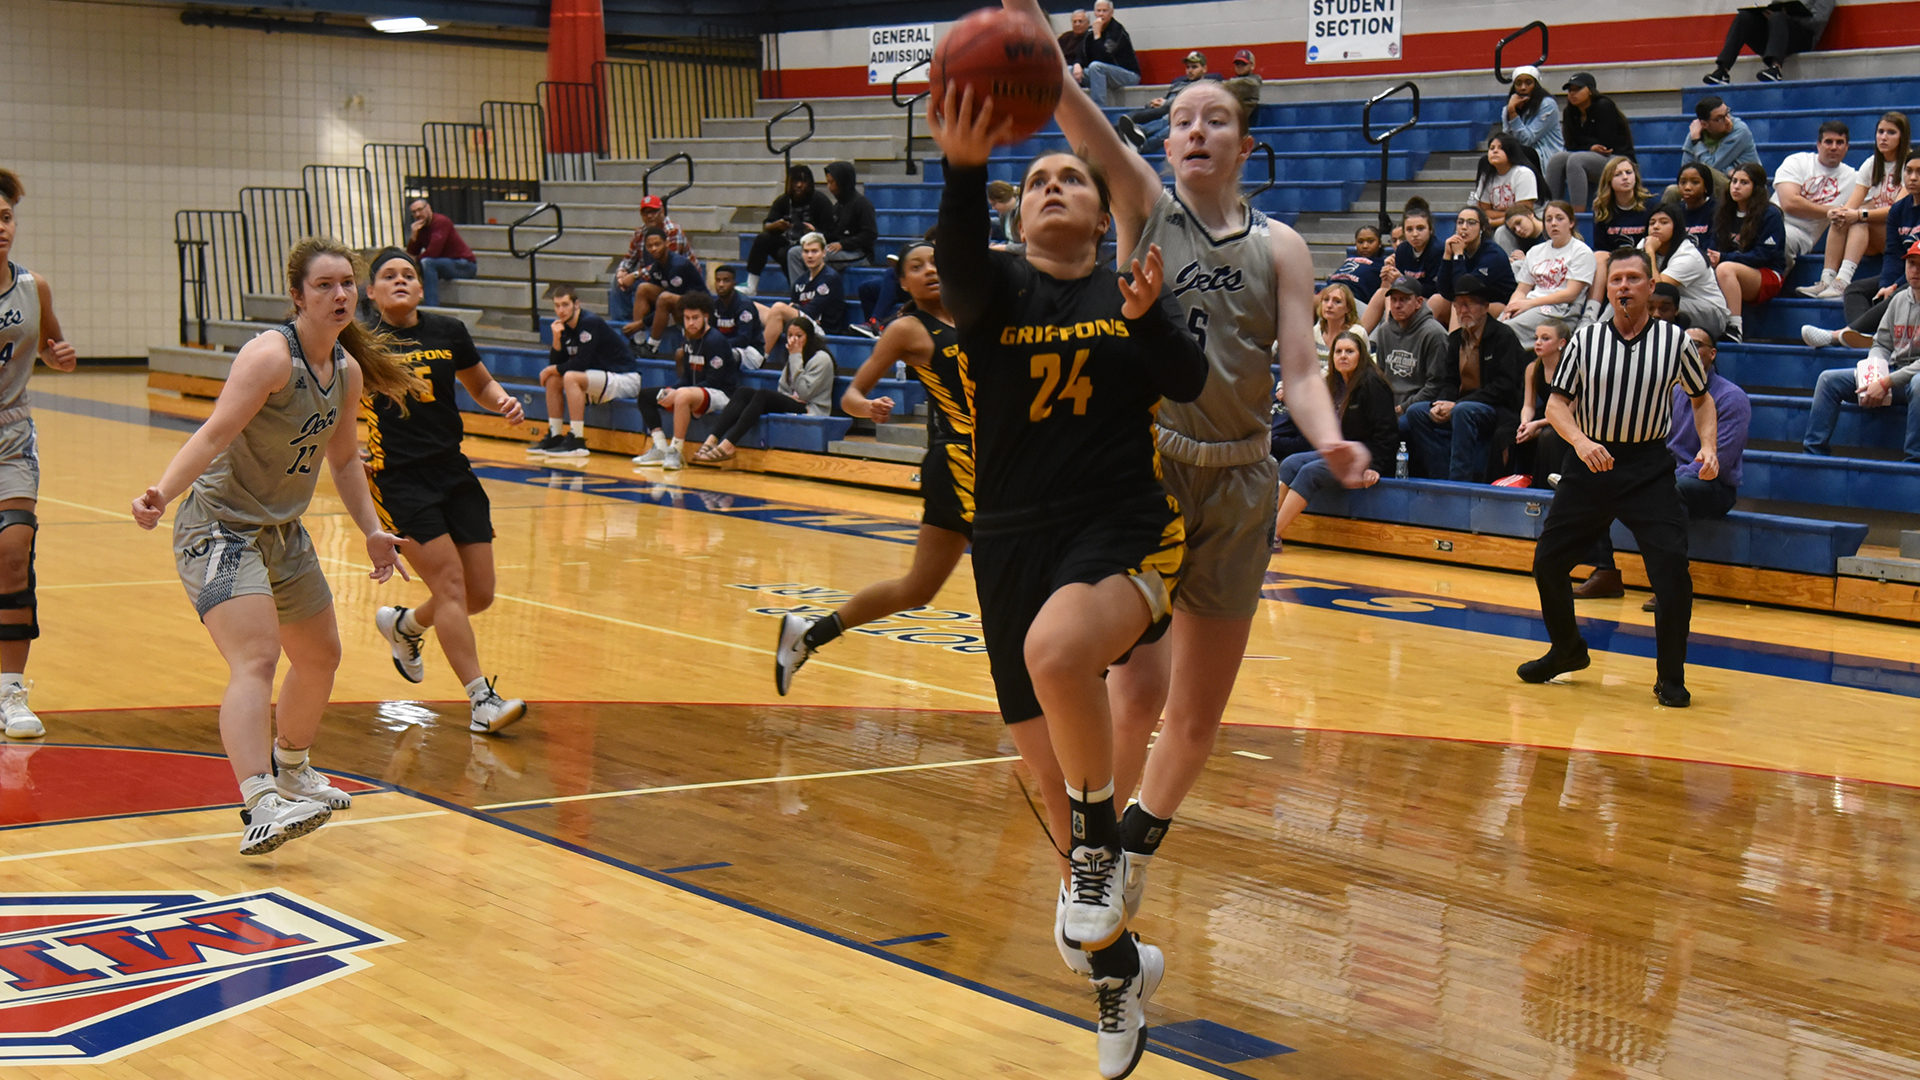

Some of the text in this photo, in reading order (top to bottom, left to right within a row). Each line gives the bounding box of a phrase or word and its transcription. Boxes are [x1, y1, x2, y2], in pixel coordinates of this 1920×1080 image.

[872, 28, 931, 45] GENERAL
[1315, 16, 1394, 38] SECTION
[870, 48, 933, 64] ADMISSION
[1173, 258, 1246, 299] Jets
[1000, 318, 1130, 346] GRIFFONS
[1029, 348, 1094, 422] 24
